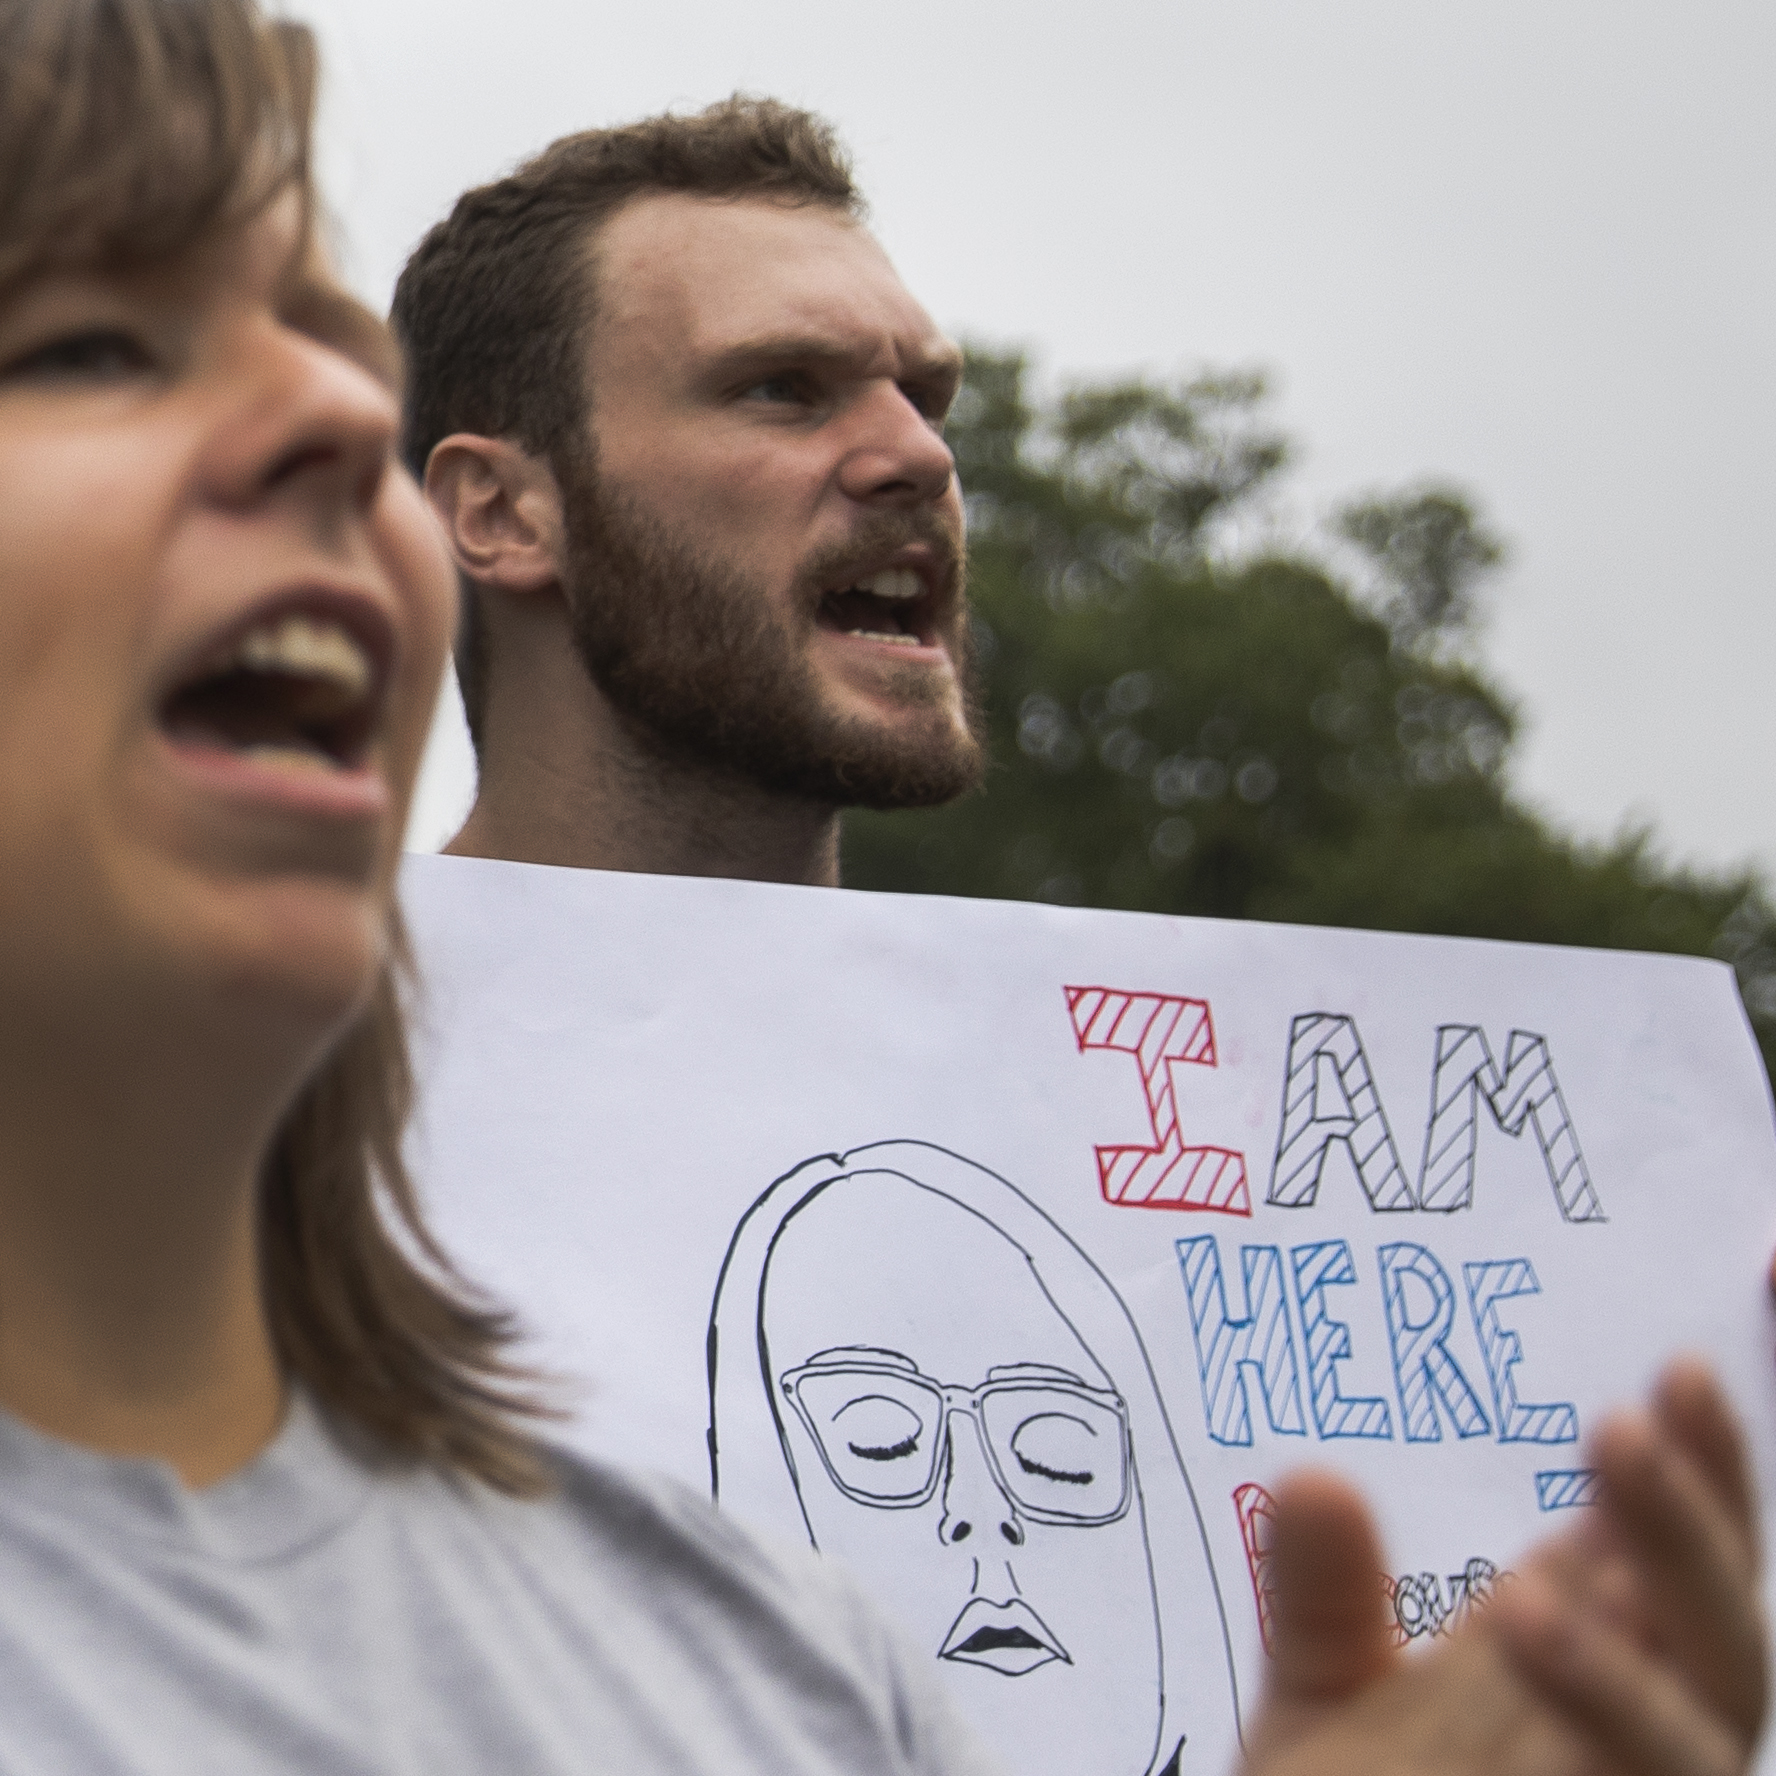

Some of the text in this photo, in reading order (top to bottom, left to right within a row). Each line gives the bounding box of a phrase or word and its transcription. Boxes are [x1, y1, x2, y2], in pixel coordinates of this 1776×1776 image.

[1063, 985, 1610, 1223] I AM
[1175, 1234, 1579, 1448] HERE
